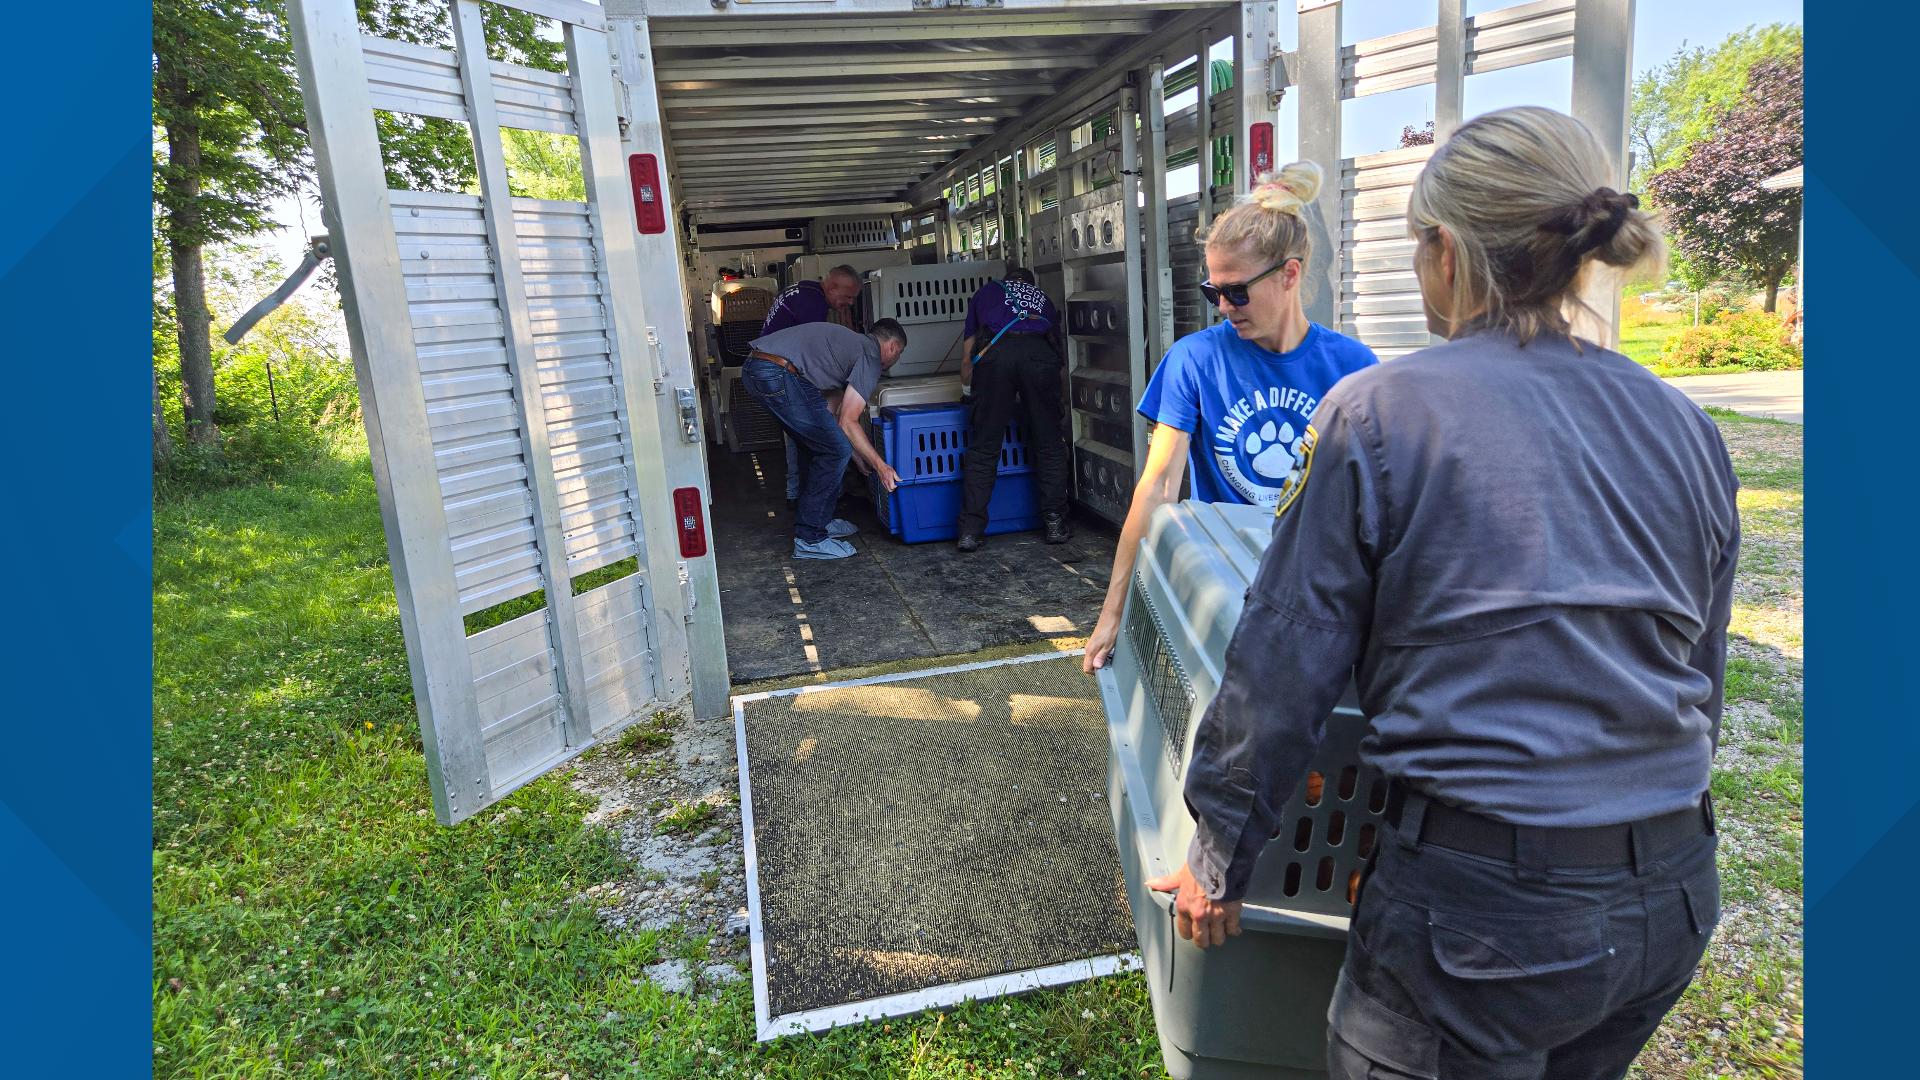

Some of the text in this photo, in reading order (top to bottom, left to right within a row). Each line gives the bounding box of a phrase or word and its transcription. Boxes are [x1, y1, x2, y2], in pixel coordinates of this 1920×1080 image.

[1214, 387, 1318, 453] I MAKE A DIFFE
[1221, 459, 1256, 499] CHANGING
[1258, 493, 1280, 502] LIVES
